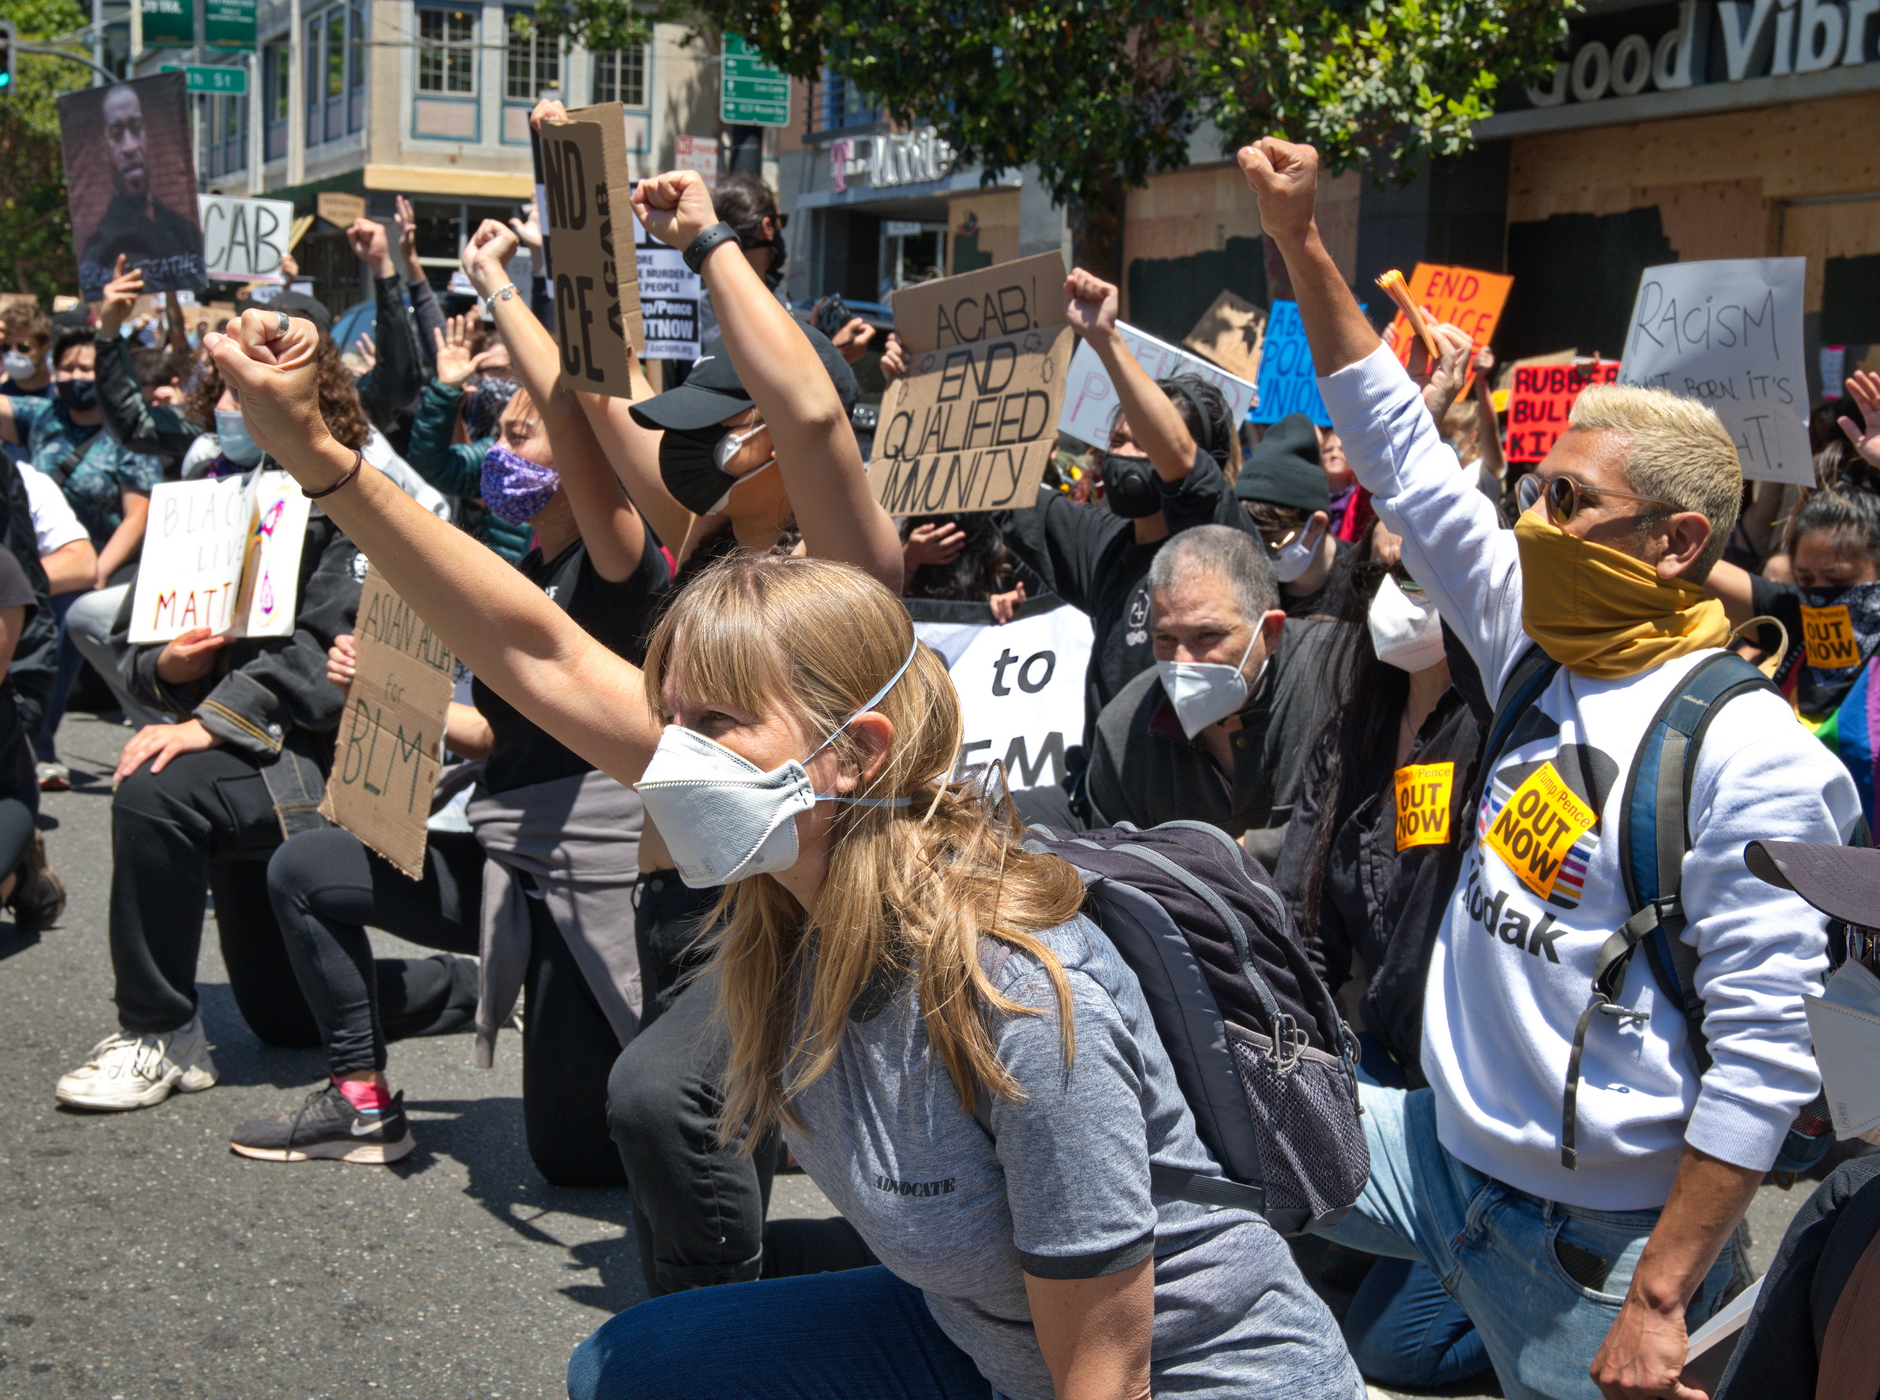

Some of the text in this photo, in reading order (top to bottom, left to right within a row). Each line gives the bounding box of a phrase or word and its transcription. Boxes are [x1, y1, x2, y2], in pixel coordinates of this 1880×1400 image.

[1717, 0, 1880, 81] Vibr
[644, 282, 680, 293] PEOPLE
[646, 268, 685, 280] MURDER
[1425, 270, 1479, 303] END
[641, 299, 693, 317] p/Pence
[936, 275, 1038, 349] ACAB!
[1268, 307, 1307, 338] AB
[937, 341, 1017, 403] END
[883, 388, 1049, 463] QUALIFIED
[880, 446, 1028, 514] IMMUNITY
[360, 592, 418, 652] ASIAN
[1806, 621, 1843, 641] OUT
[991, 647, 1056, 697] to
[1808, 640, 1852, 660] NOW
[341, 696, 423, 817] BLM
[1401, 783, 1443, 813] OUT
[1517, 788, 1572, 850] OUT
[1536, 764, 1592, 829] Trump/Pence
[1398, 808, 1446, 841] NOW
[1493, 808, 1560, 883] NOW
[873, 1175, 956, 1198] ADVOCATE
